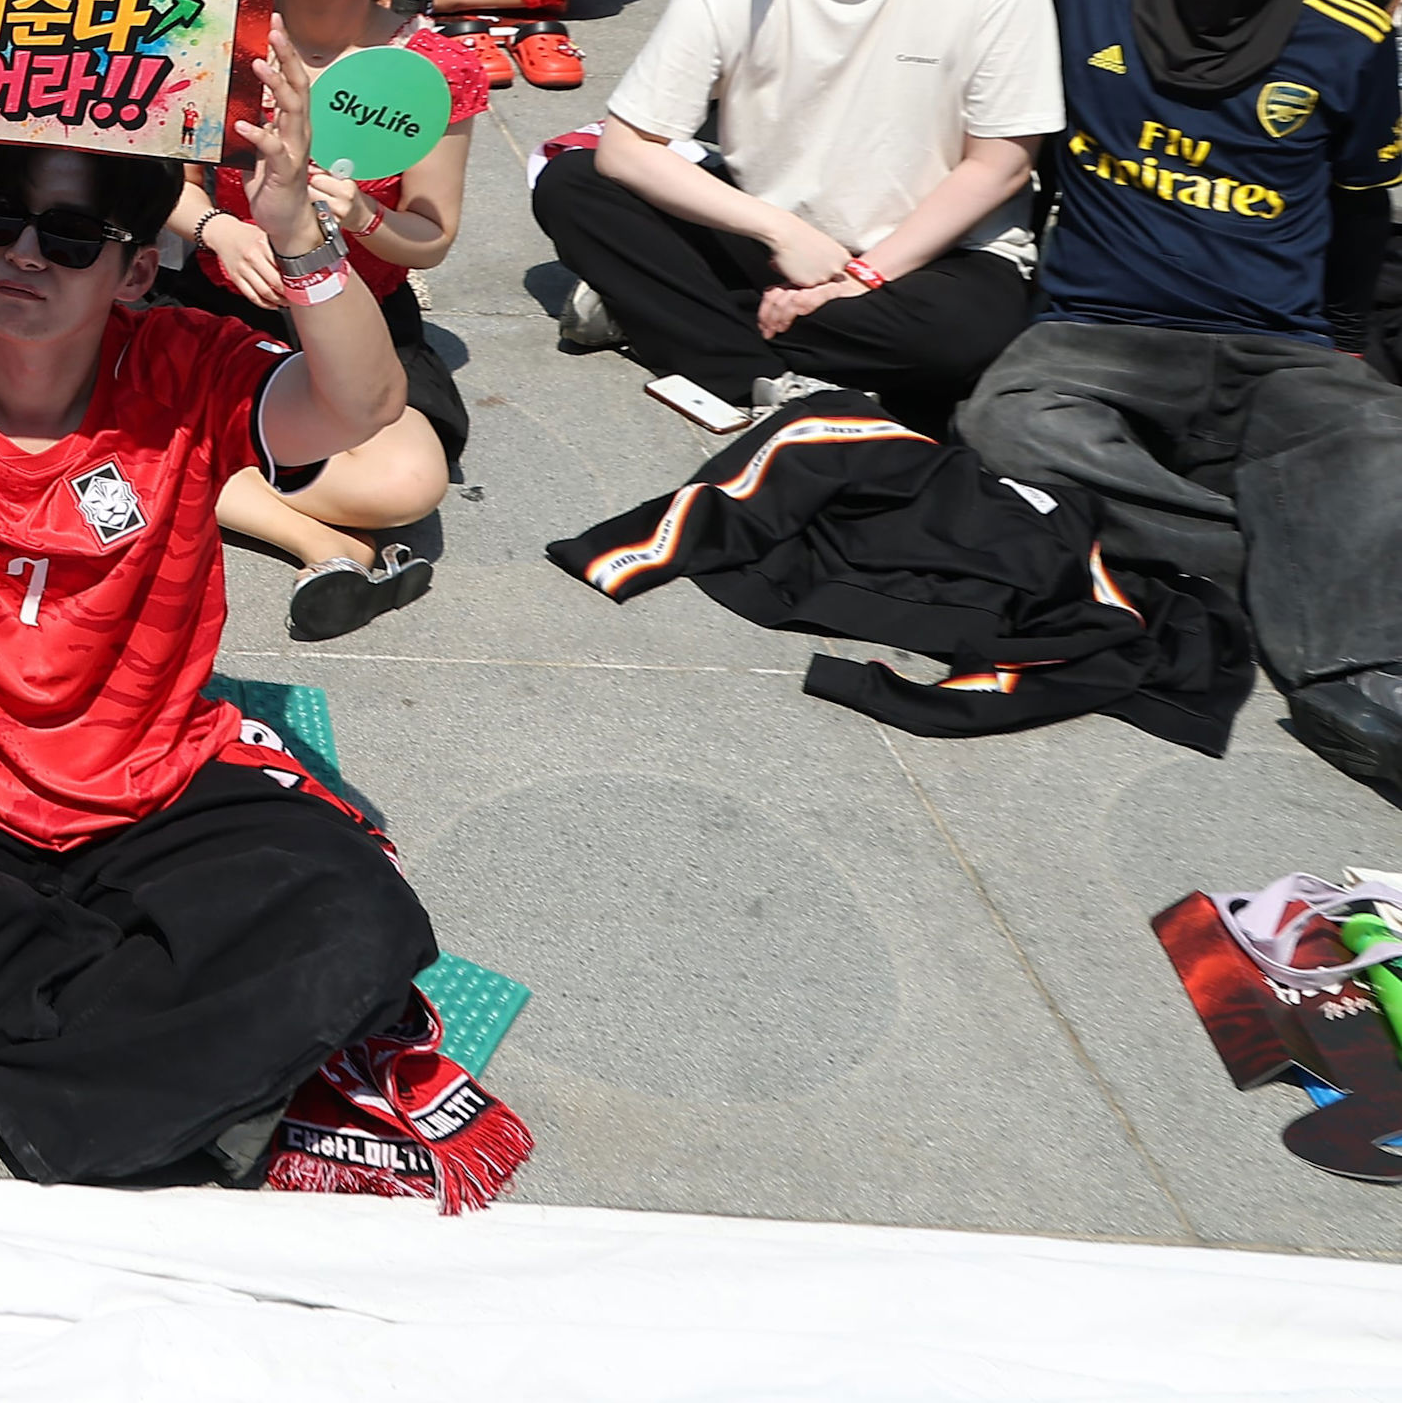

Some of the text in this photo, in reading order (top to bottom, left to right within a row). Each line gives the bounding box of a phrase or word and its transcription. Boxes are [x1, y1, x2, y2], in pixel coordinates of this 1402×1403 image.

[328, 89, 421, 139] SkyLife
[1137, 119, 1212, 167] Fly
[1067, 127, 1286, 221] Emirates
[6, 556, 50, 628] 7
